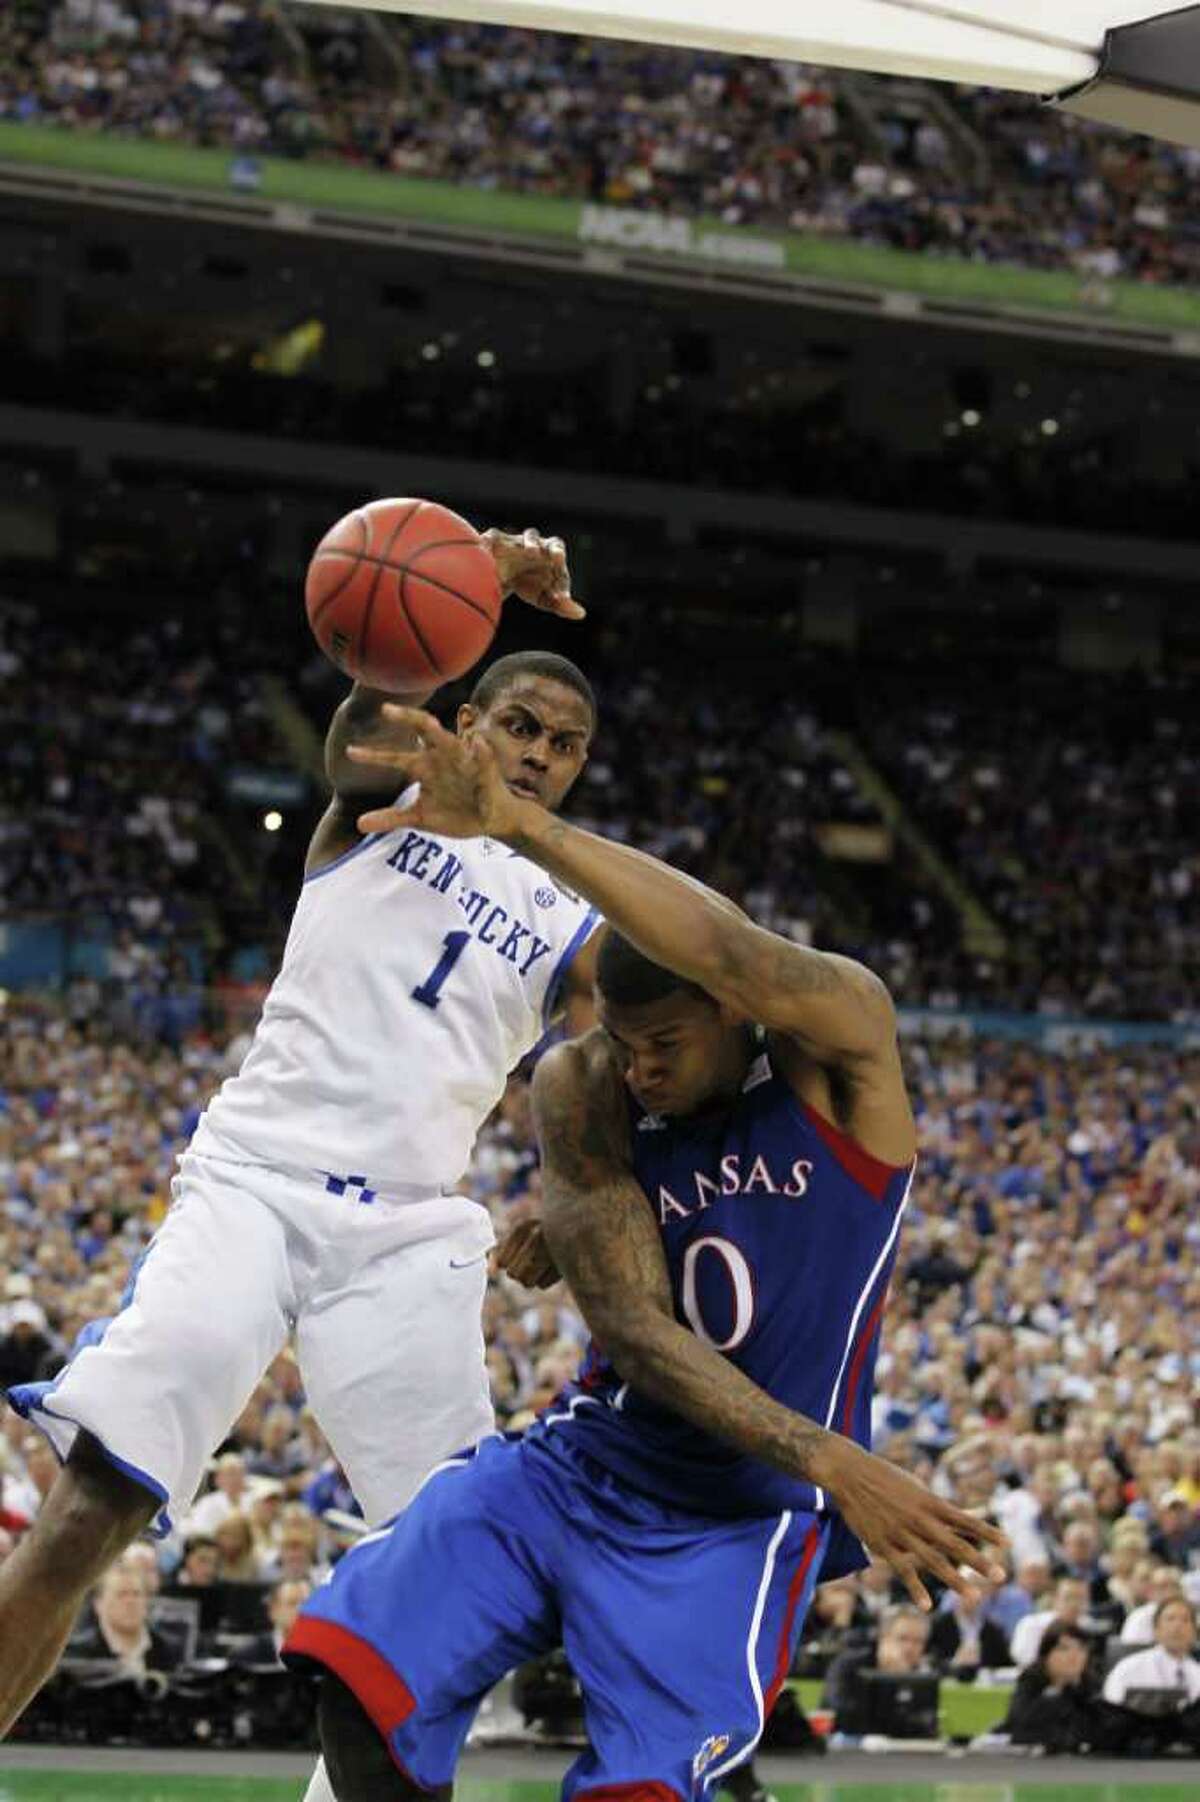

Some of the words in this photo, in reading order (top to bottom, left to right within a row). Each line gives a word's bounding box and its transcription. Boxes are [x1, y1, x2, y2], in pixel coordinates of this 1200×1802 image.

[386, 831, 551, 976] KENUCKY
[411, 931, 471, 1009] 1
[659, 1154, 813, 1224] ANSAS
[682, 1236, 754, 1350] 0
